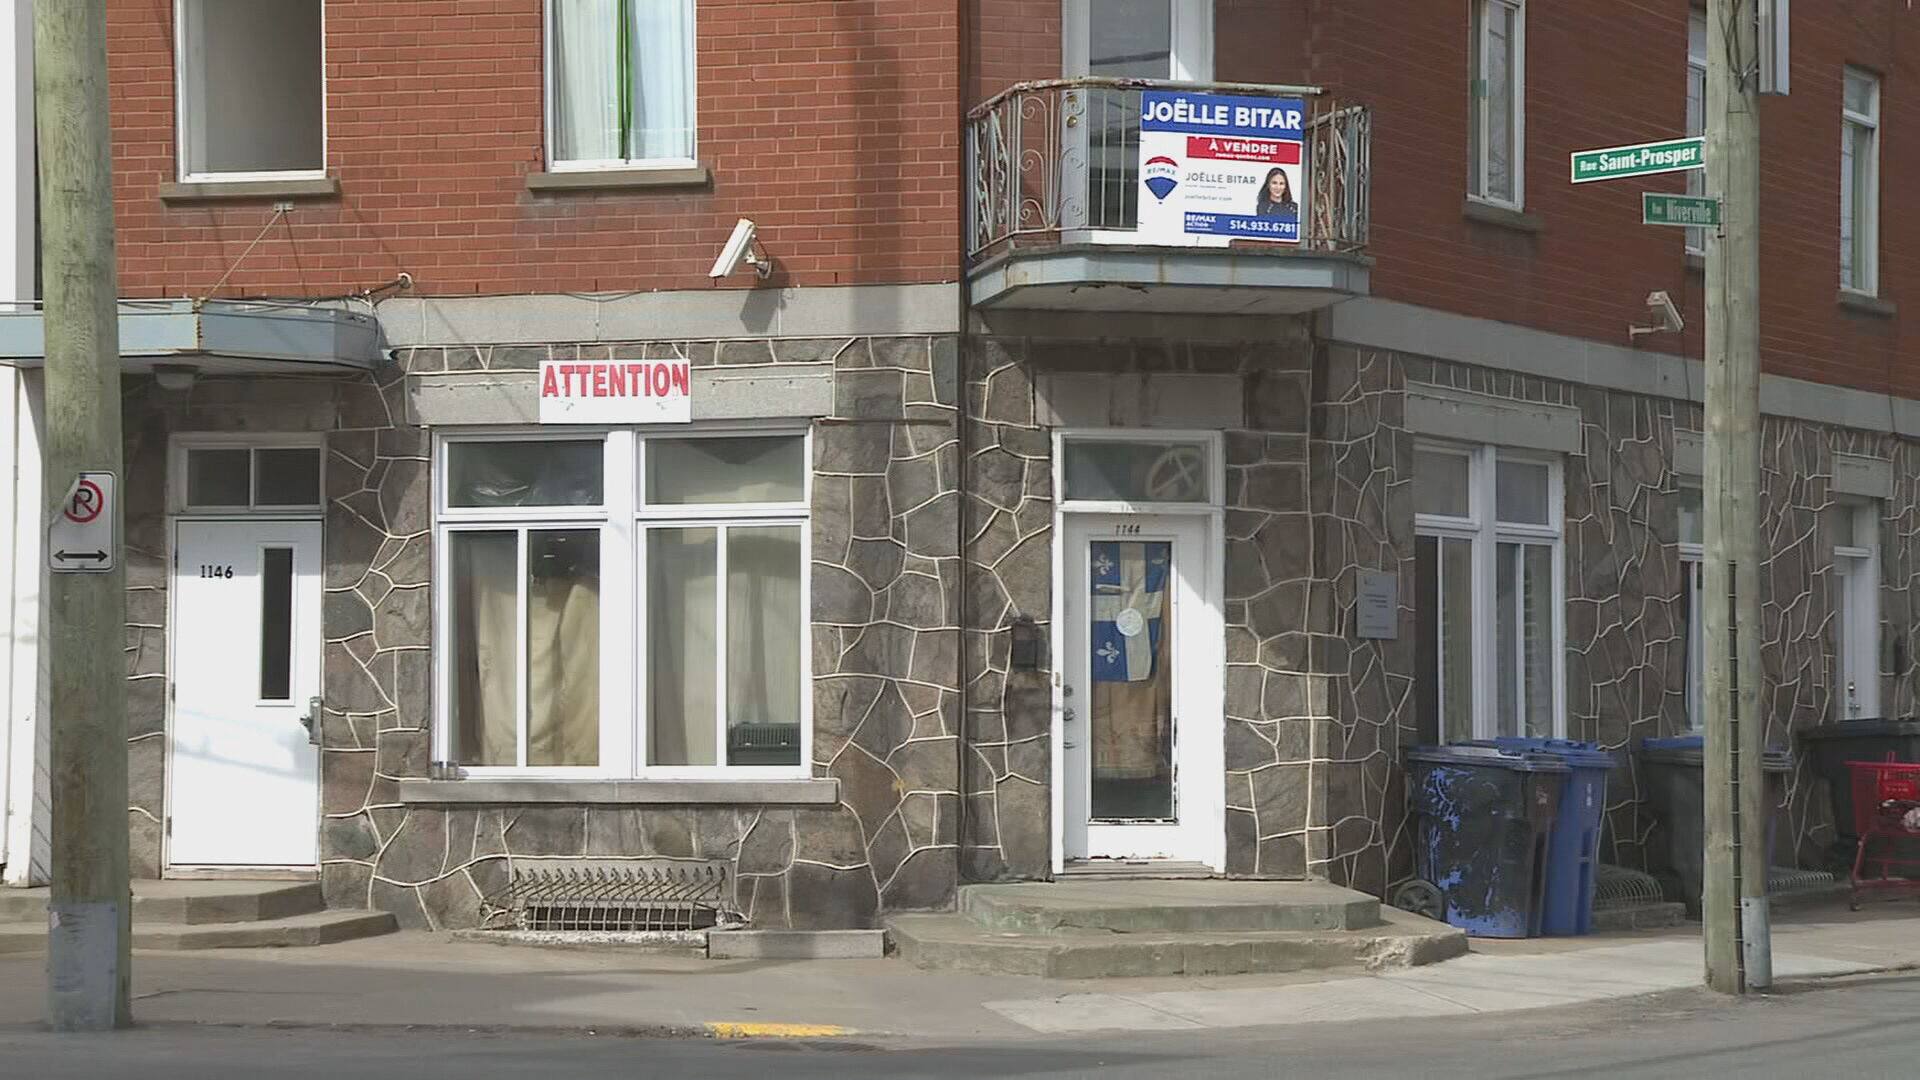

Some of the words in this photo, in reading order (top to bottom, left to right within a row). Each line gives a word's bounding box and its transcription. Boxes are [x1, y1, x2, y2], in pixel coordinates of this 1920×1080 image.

[1143, 98, 1229, 126] JOËLLE
[1235, 106, 1301, 130] BITAR
[1223, 141, 1278, 155] VENDRE
[1580, 160, 1597, 172] Rue
[1599, 147, 1697, 171] Saint-Prosper
[1226, 175, 1256, 185] BITAR
[1229, 219, 1296, 233] 514.933.6781
[542, 363, 688, 397] ATTENTION
[200, 565, 233, 579] 1146
